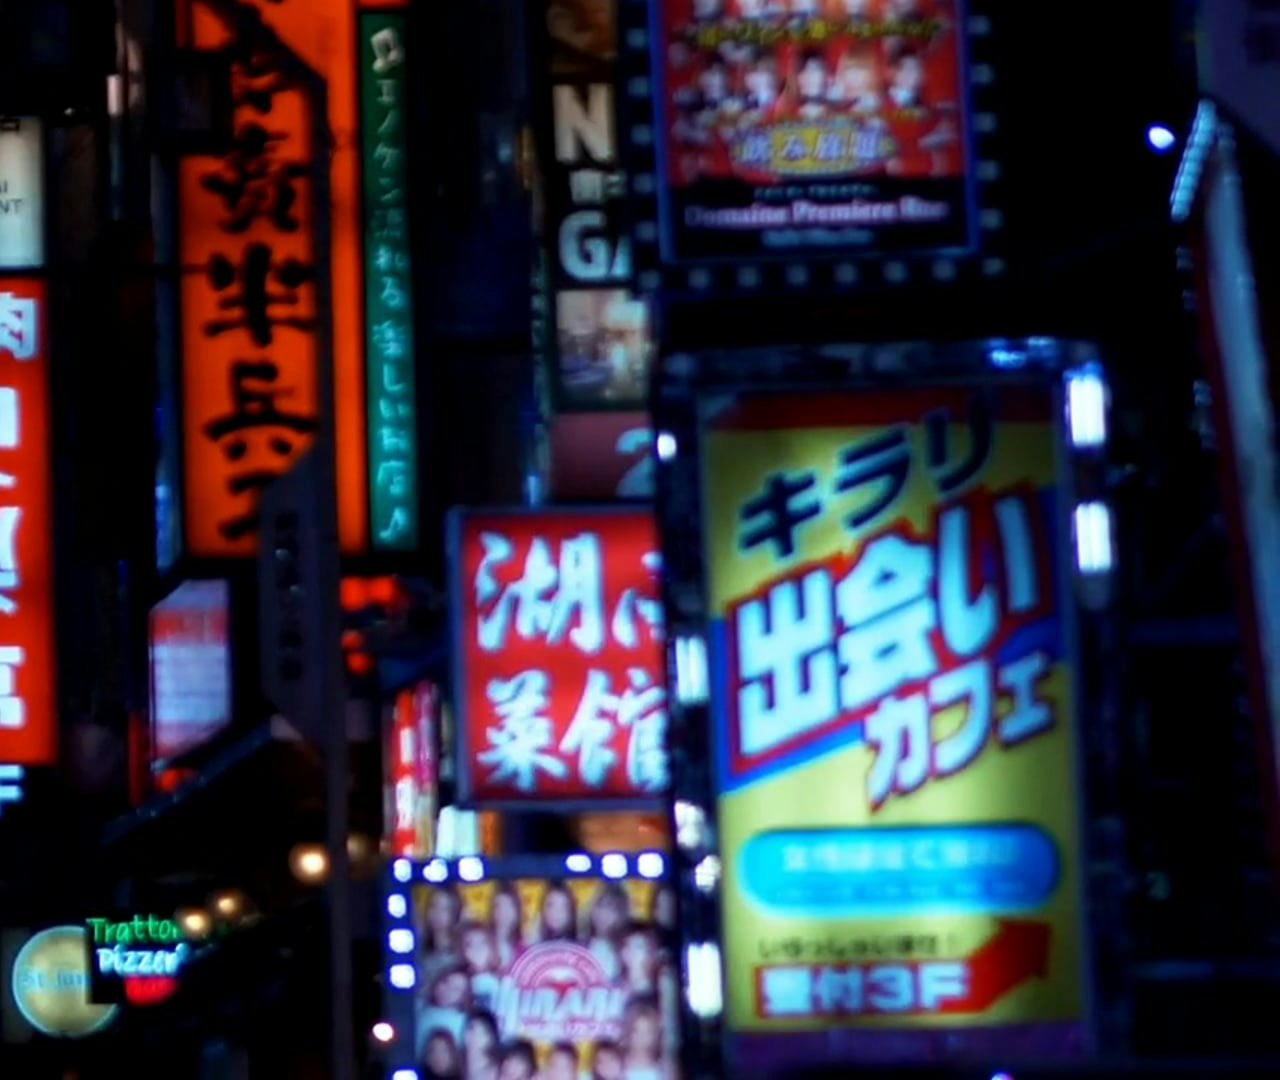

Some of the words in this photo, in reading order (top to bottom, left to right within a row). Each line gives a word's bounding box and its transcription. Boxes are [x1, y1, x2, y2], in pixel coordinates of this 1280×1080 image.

[736, 400, 993, 562] キラリ
[737, 493, 1040, 758] 出会い
[865, 652, 1054, 812] カフェ
